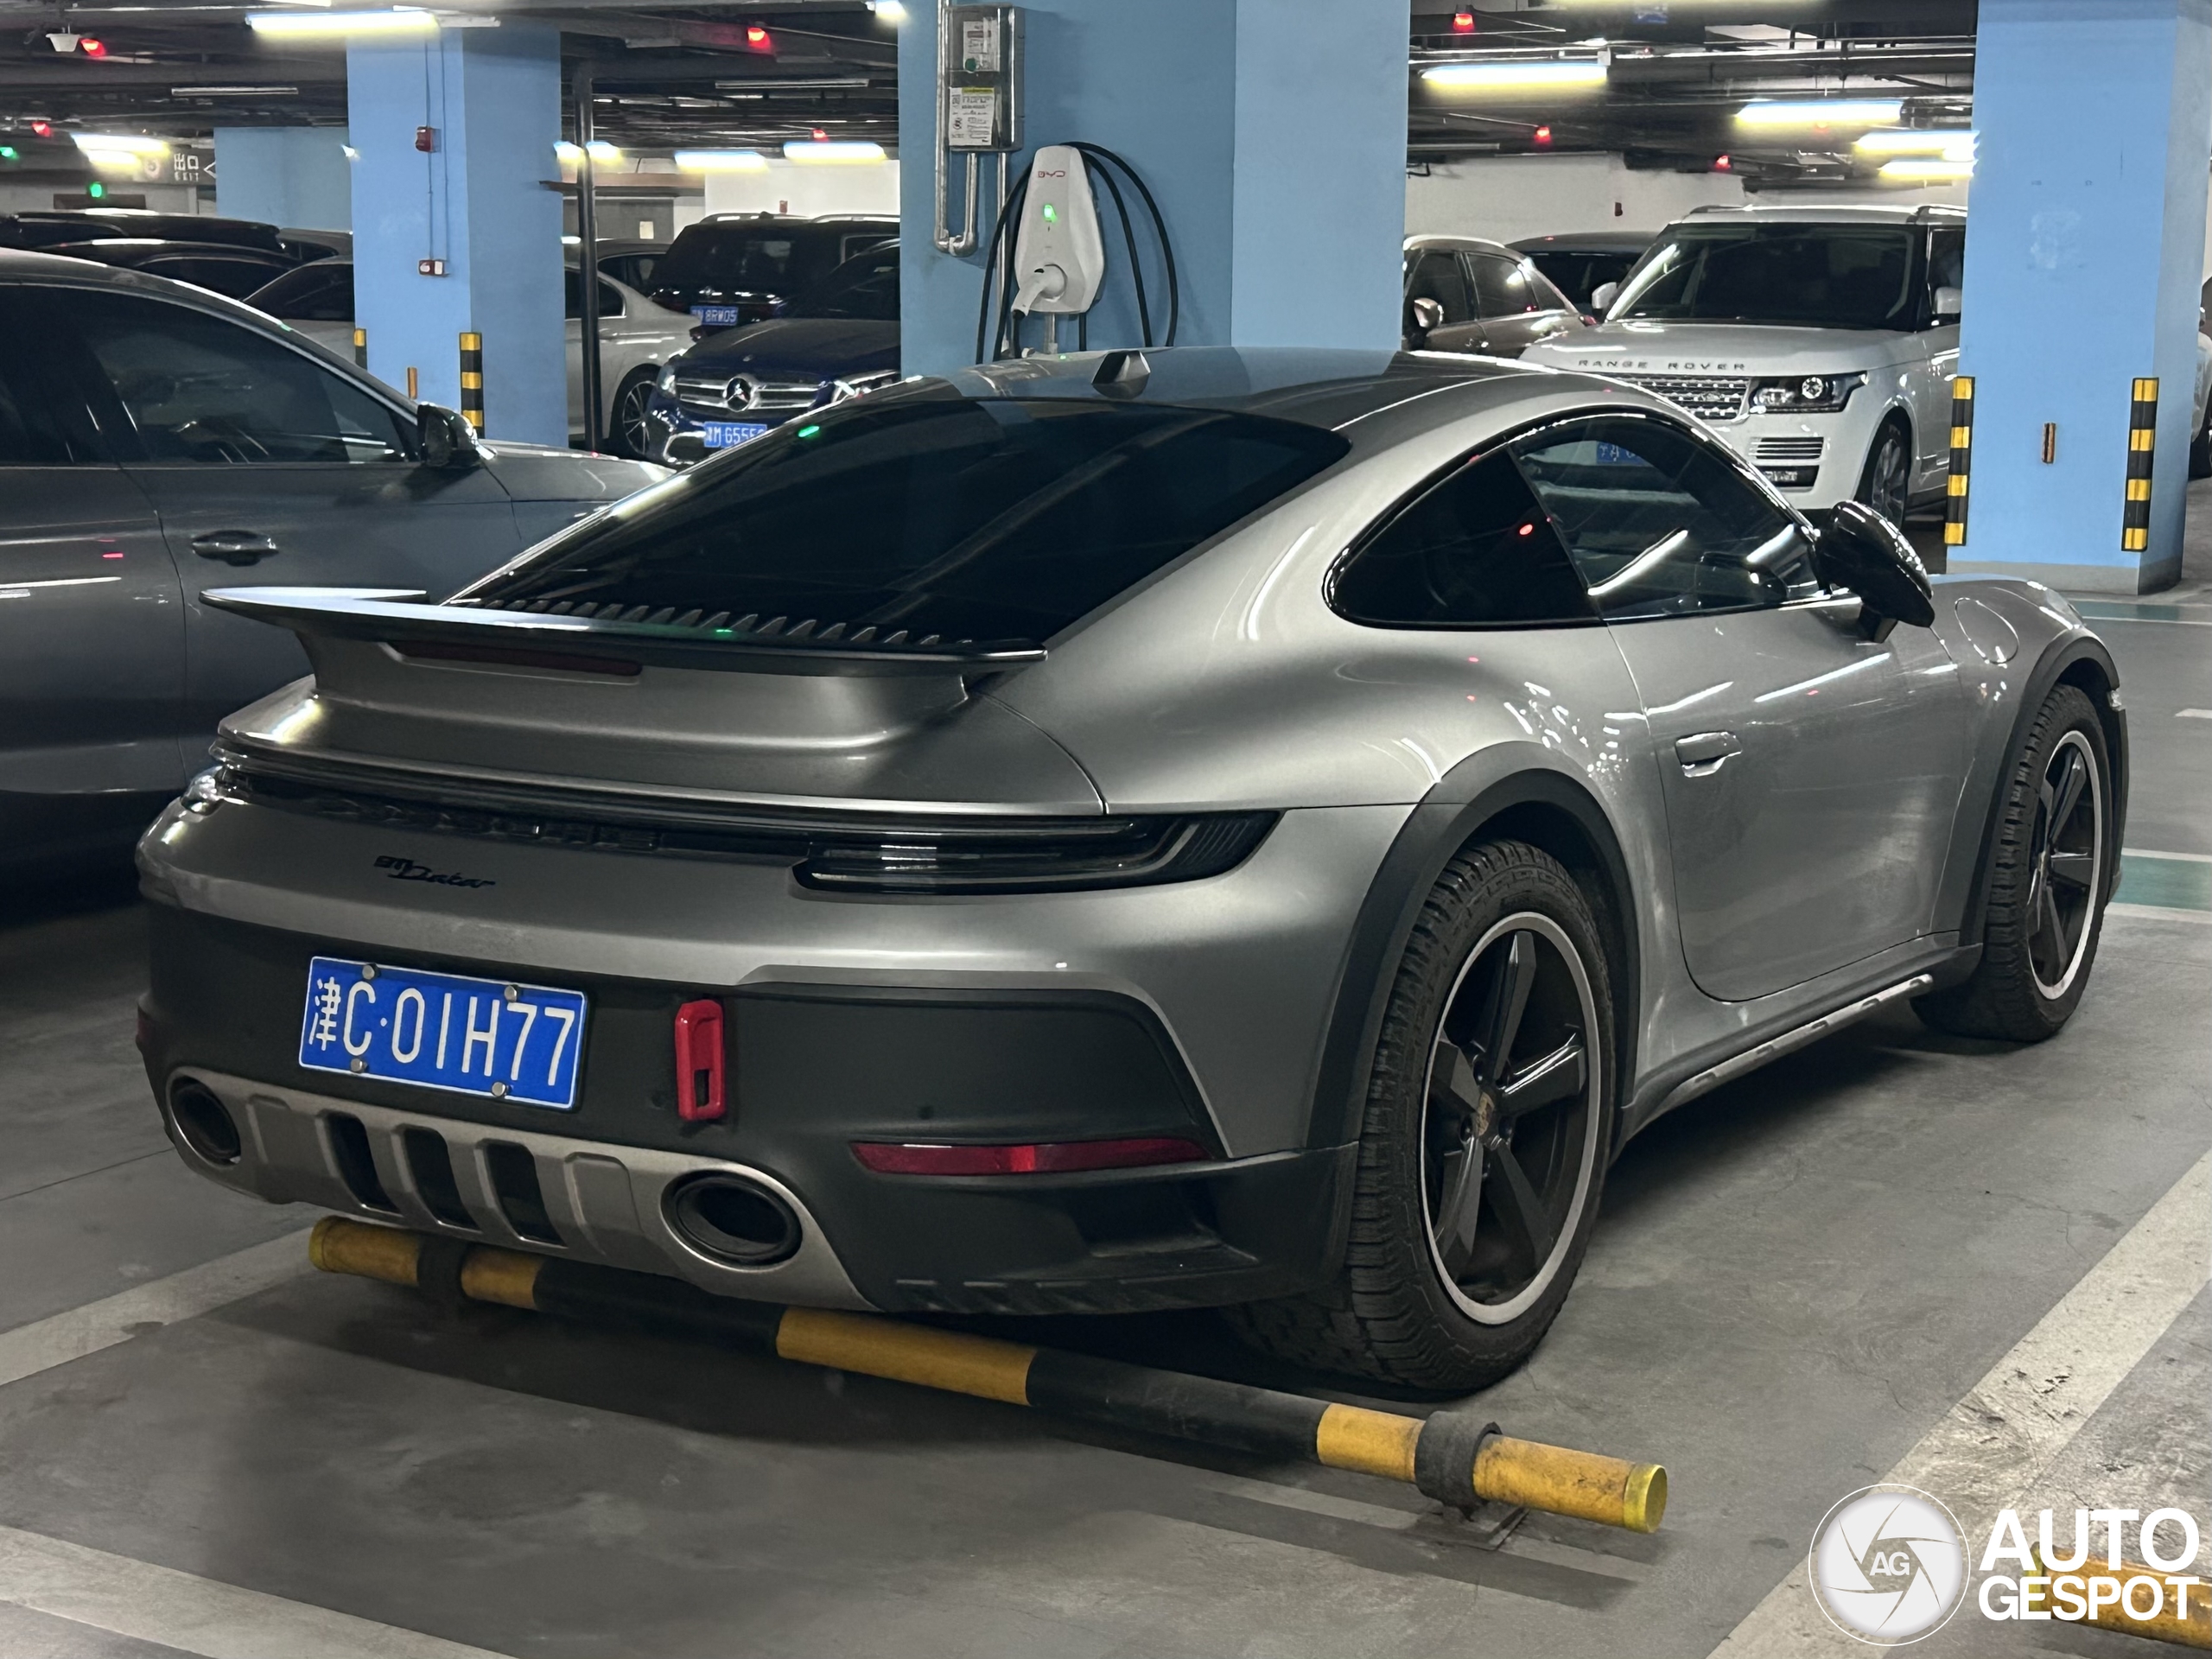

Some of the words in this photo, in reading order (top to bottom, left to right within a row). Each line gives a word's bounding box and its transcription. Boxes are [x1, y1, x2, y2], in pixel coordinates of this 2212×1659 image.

[174, 153, 199, 171] 出口
[1579, 359, 1649, 369] RANGE
[1668, 362, 1745, 371] ROVER
